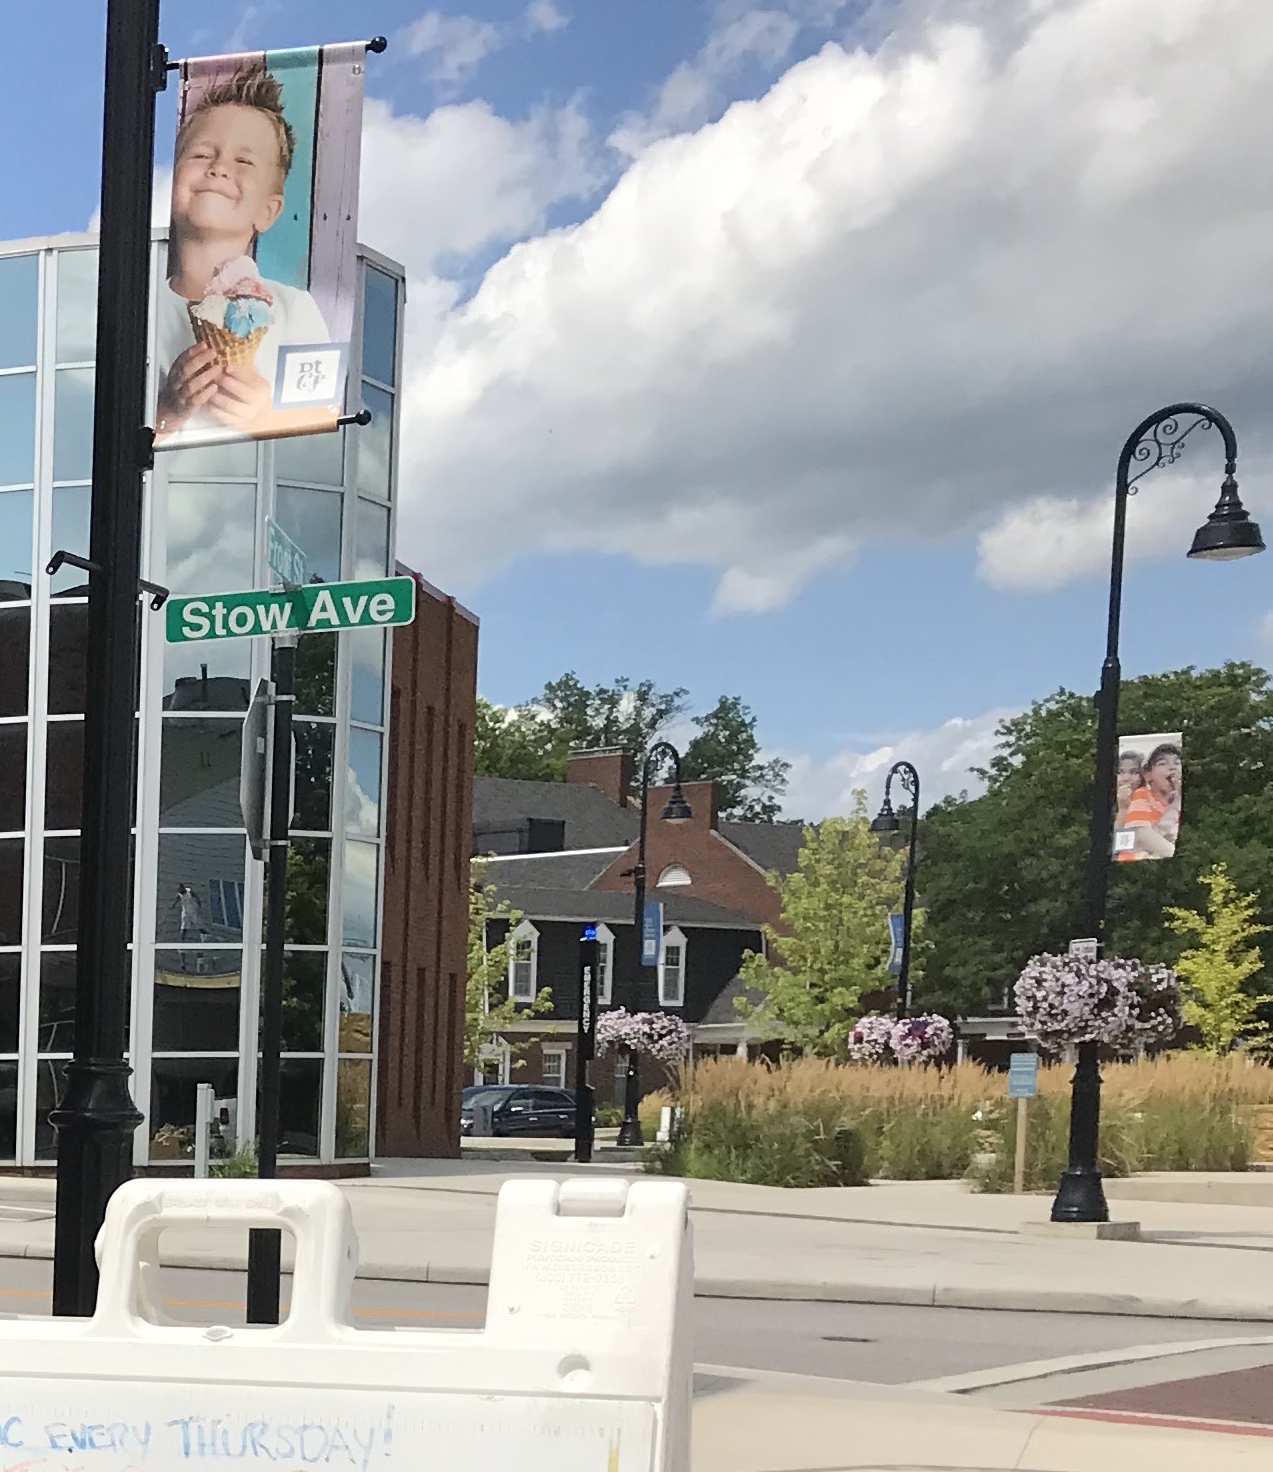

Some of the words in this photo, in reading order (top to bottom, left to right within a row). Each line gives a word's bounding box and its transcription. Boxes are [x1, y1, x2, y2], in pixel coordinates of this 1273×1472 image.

[182, 601, 293, 638] Stow
[307, 590, 396, 628] Ave
[44, 1420, 152, 1462] EVERY
